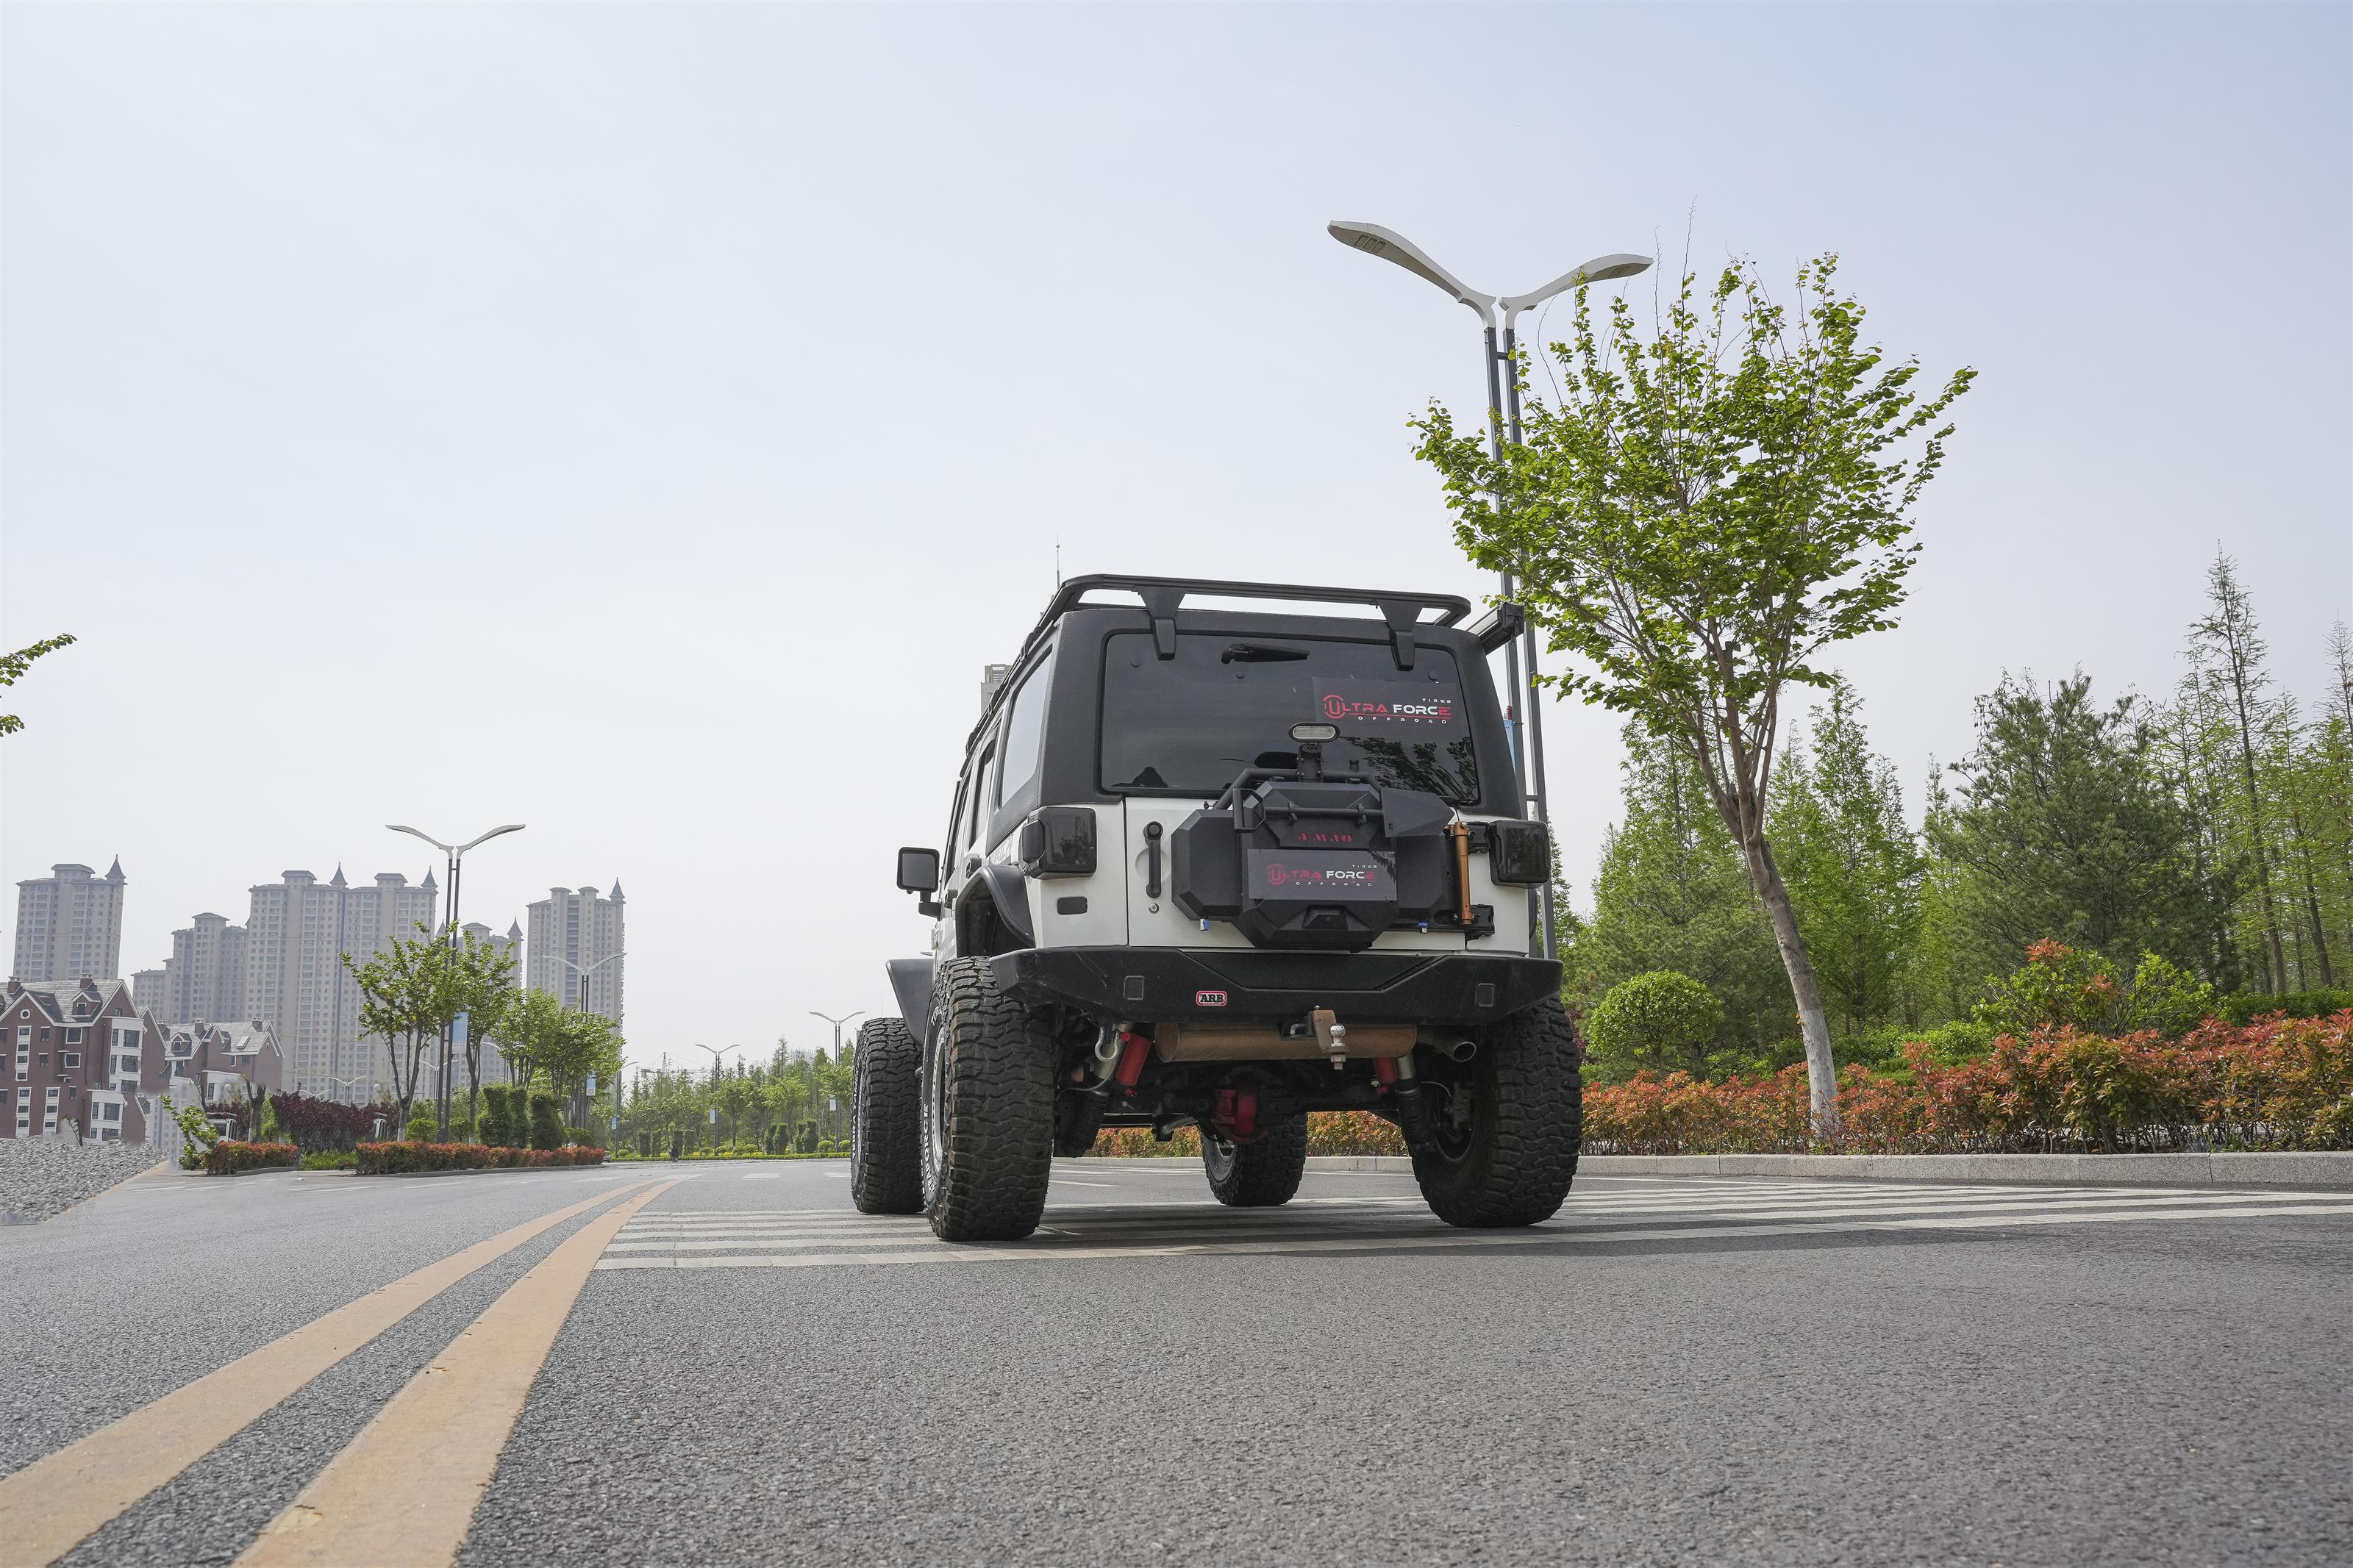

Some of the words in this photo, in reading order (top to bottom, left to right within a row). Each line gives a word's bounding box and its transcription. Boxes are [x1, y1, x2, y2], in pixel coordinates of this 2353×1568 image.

[1327, 698, 1389, 716] ULTRA
[1393, 704, 1452, 716] FORCE
[1271, 868, 1323, 883] ULTRA
[1326, 870, 1377, 880] FORCE
[1199, 994, 1224, 1003] ARB
